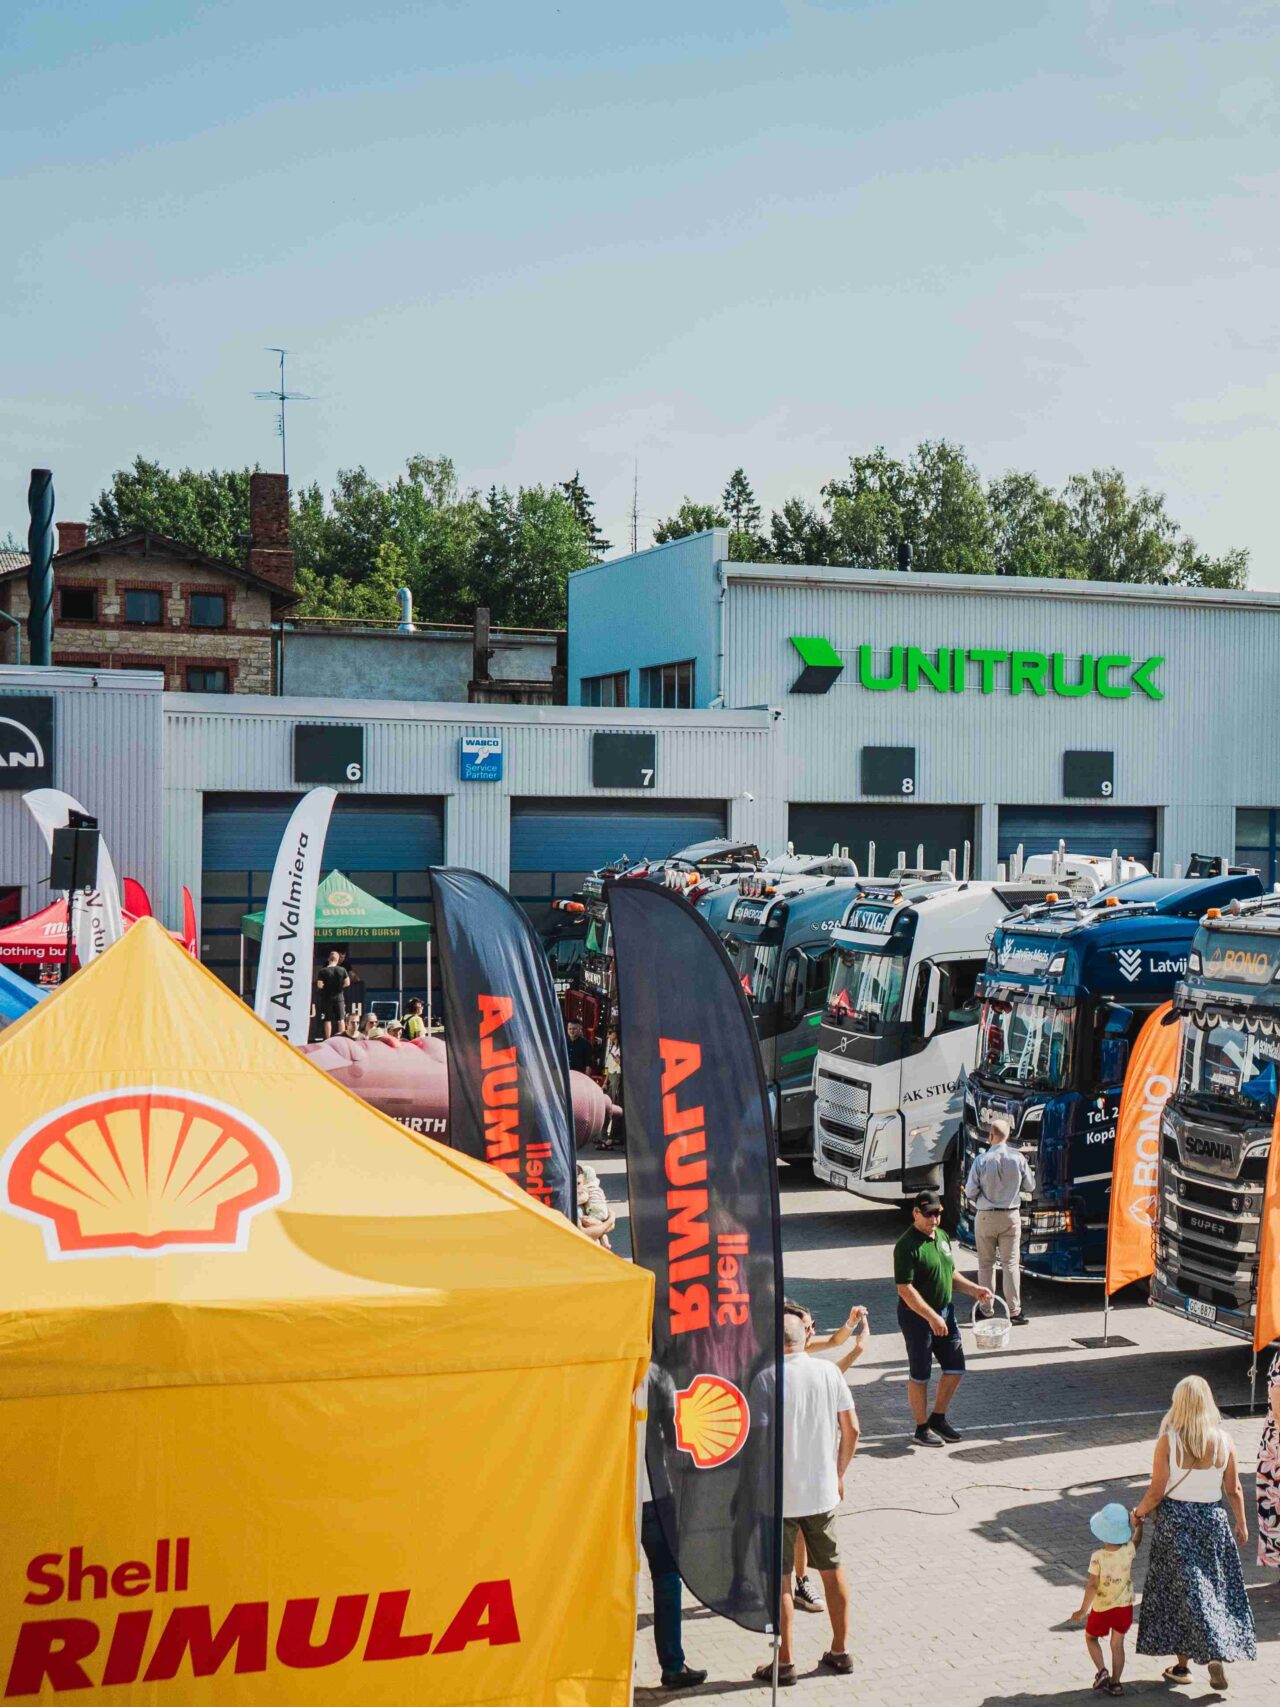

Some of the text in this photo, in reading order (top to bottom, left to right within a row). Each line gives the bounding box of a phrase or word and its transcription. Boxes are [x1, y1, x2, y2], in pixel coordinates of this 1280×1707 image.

[859, 644, 1166, 700] UNITRUCK
[465, 739, 499, 747] WABCO
[346, 763, 361, 781] 6
[465, 764, 497, 772] Service
[465, 771, 497, 780] Partner
[640, 769, 653, 786] 7
[901, 777, 914, 793] 8
[1101, 781, 1112, 796] 9
[278, 832, 309, 941] Valmiera
[1150, 958, 1187, 975] Latvij
[1224, 950, 1268, 976] BONO
[270, 952, 296, 1010] Auto
[903, 1089, 923, 1104] AK
[1087, 1111, 1109, 1125] Tel.
[1133, 1074, 1173, 1187] BONO
[1185, 1137, 1234, 1162] SCANIA
[1190, 1217, 1225, 1234] SUPER
[1189, 1301, 1216, 1321] GC-8877
[23, 1537, 190, 1606] Shell
[4, 1579, 520, 1697] RIMULA
